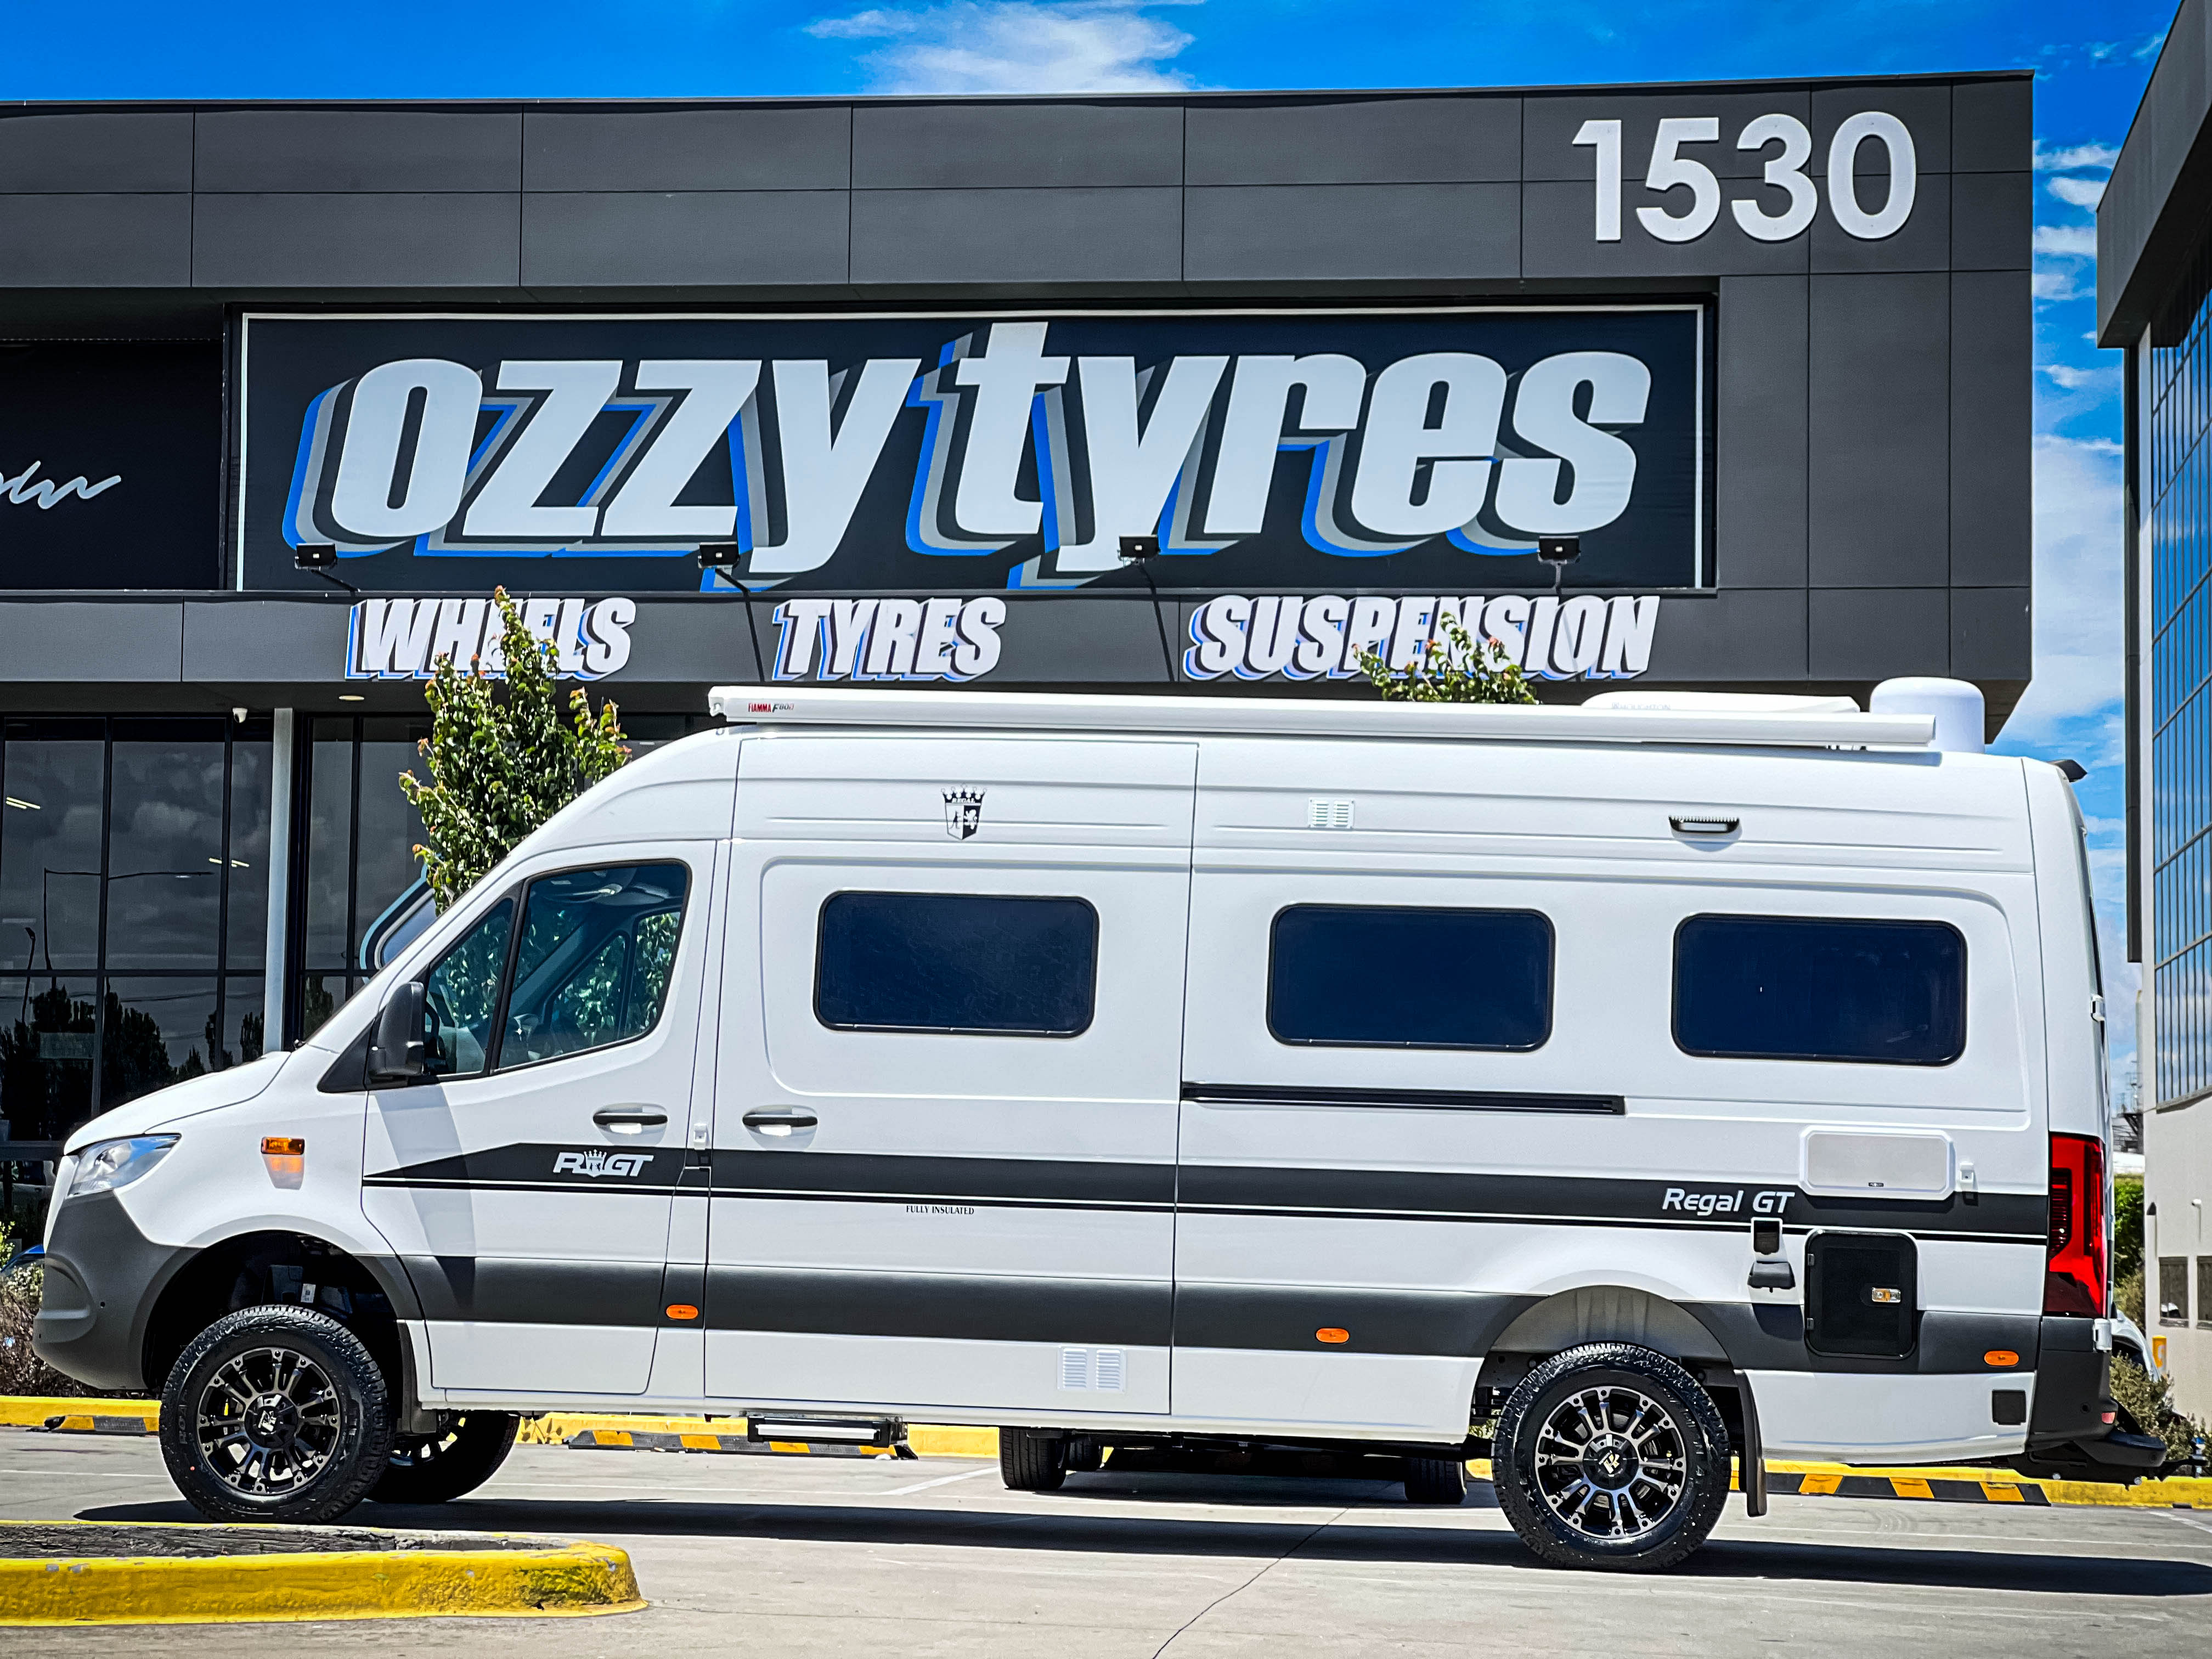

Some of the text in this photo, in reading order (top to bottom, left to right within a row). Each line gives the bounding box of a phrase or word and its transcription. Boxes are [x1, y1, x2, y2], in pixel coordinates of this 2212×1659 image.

[1572, 111, 1917, 242] 1530
[772, 597, 1006, 682] TYRES
[1183, 595, 1661, 681] SUSPENSION
[748, 703, 771, 713] FIAMMA
[906, 1205, 975, 1215] FULLY INSULATED
[1662, 1188, 1796, 1216] Regal GT
